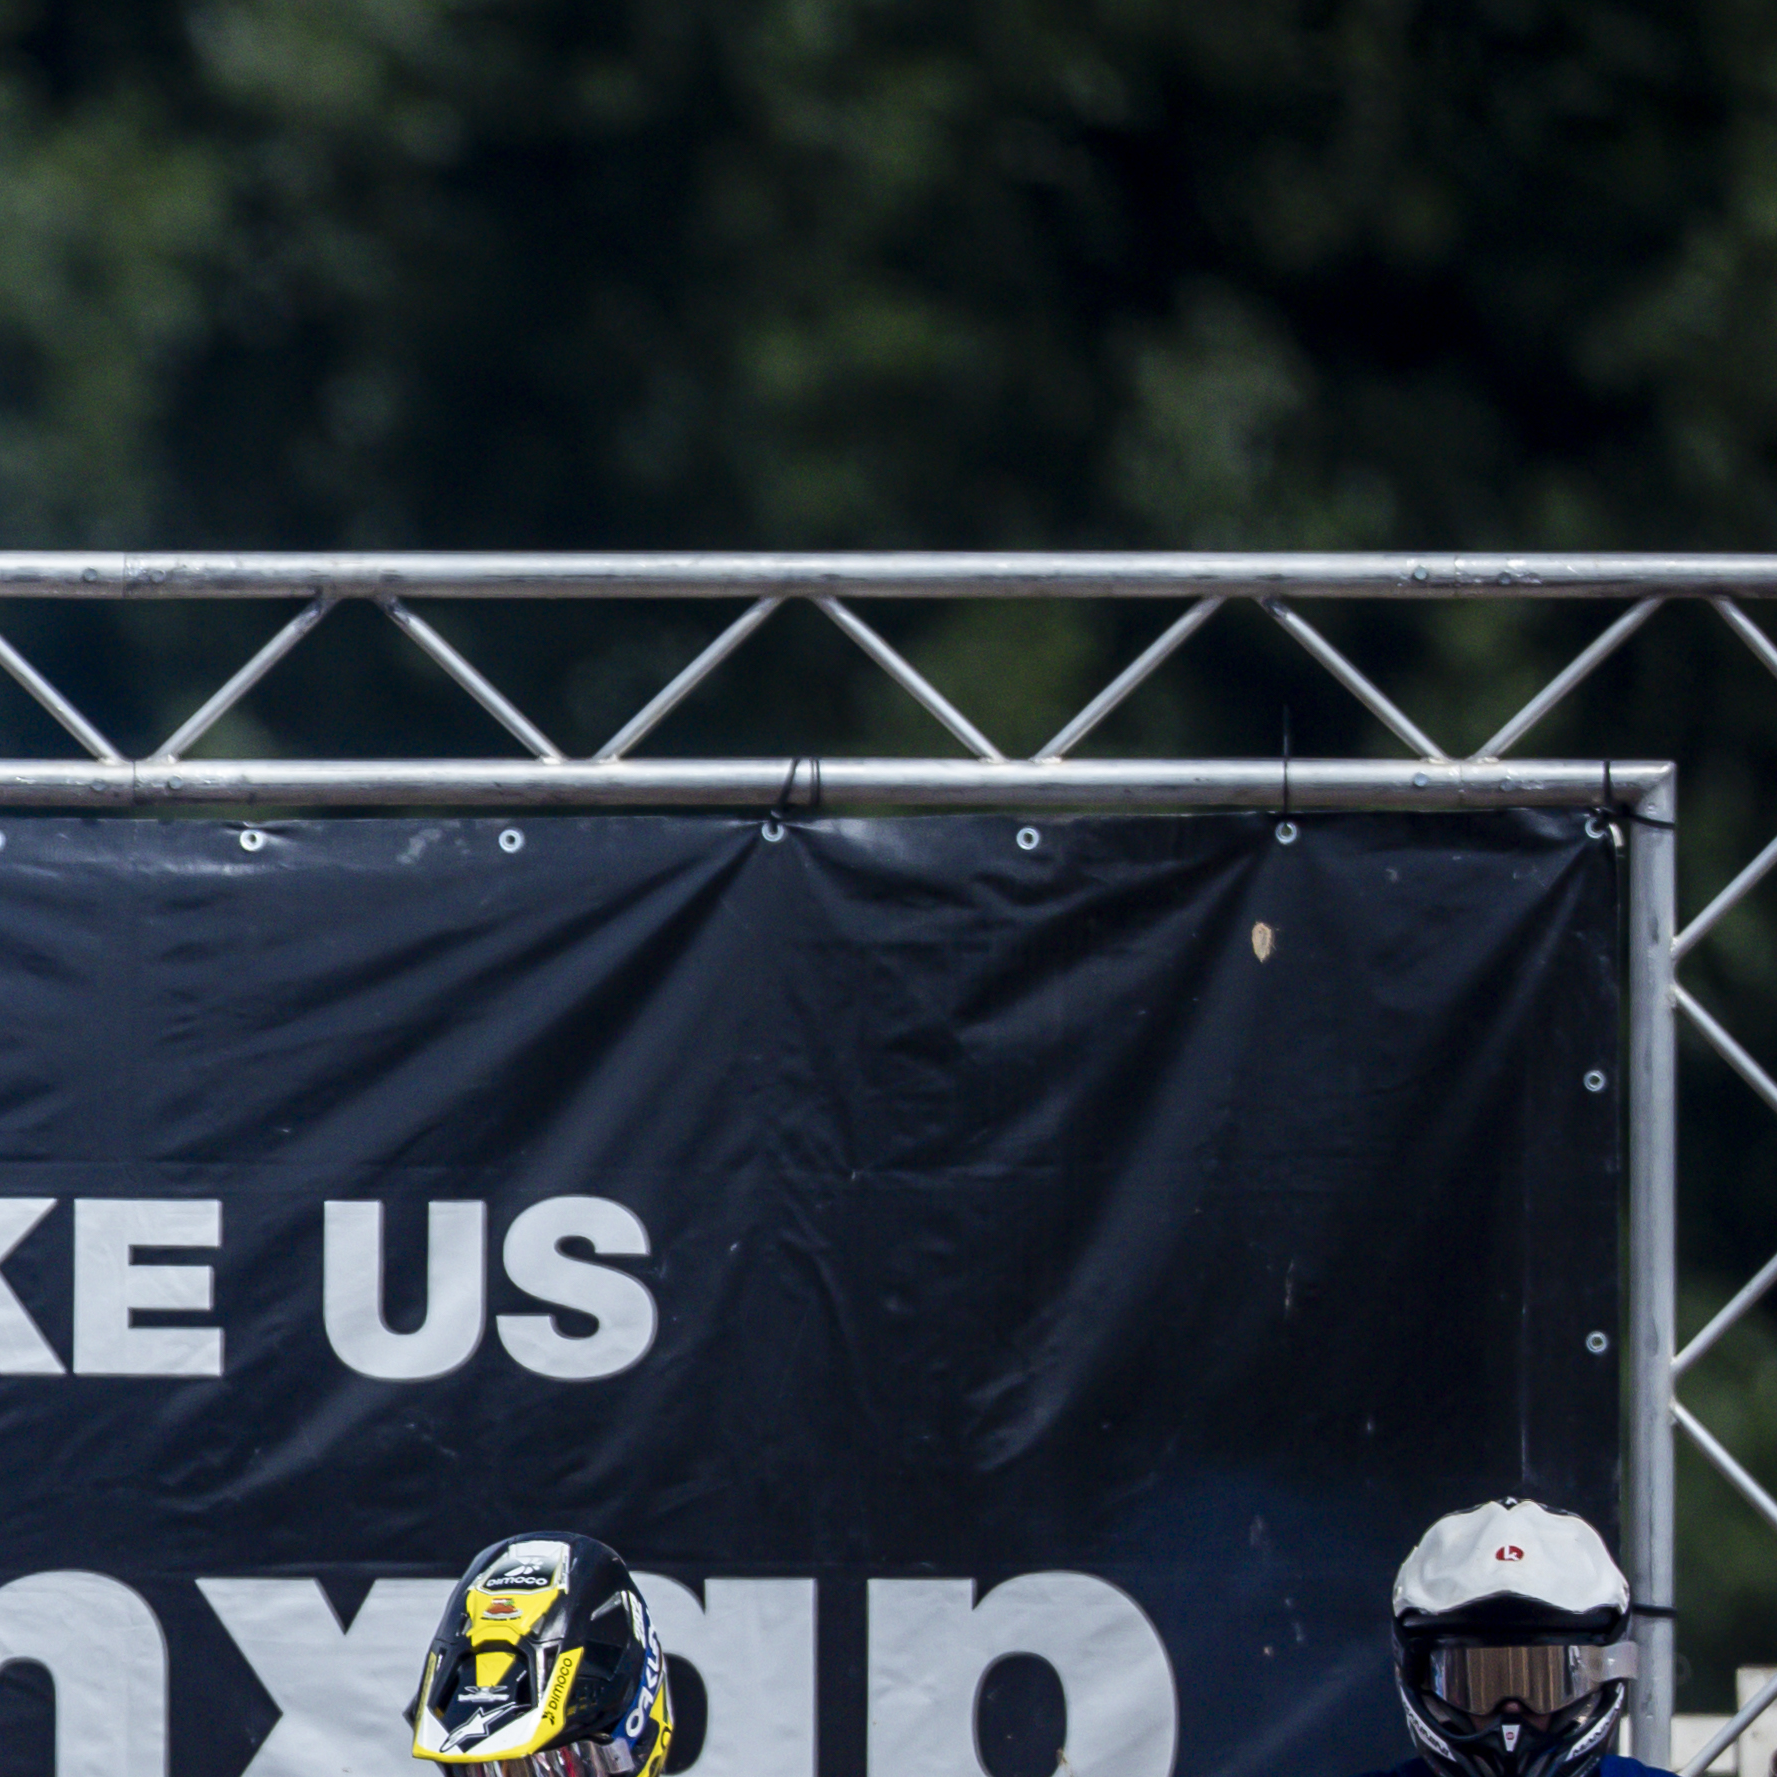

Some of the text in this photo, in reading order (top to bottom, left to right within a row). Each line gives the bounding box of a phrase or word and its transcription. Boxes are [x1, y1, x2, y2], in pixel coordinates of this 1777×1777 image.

[323, 1194, 658, 1382] US
[485, 1574, 548, 1588] DIMOCO
[547, 1656, 574, 1711] DIMOCO
